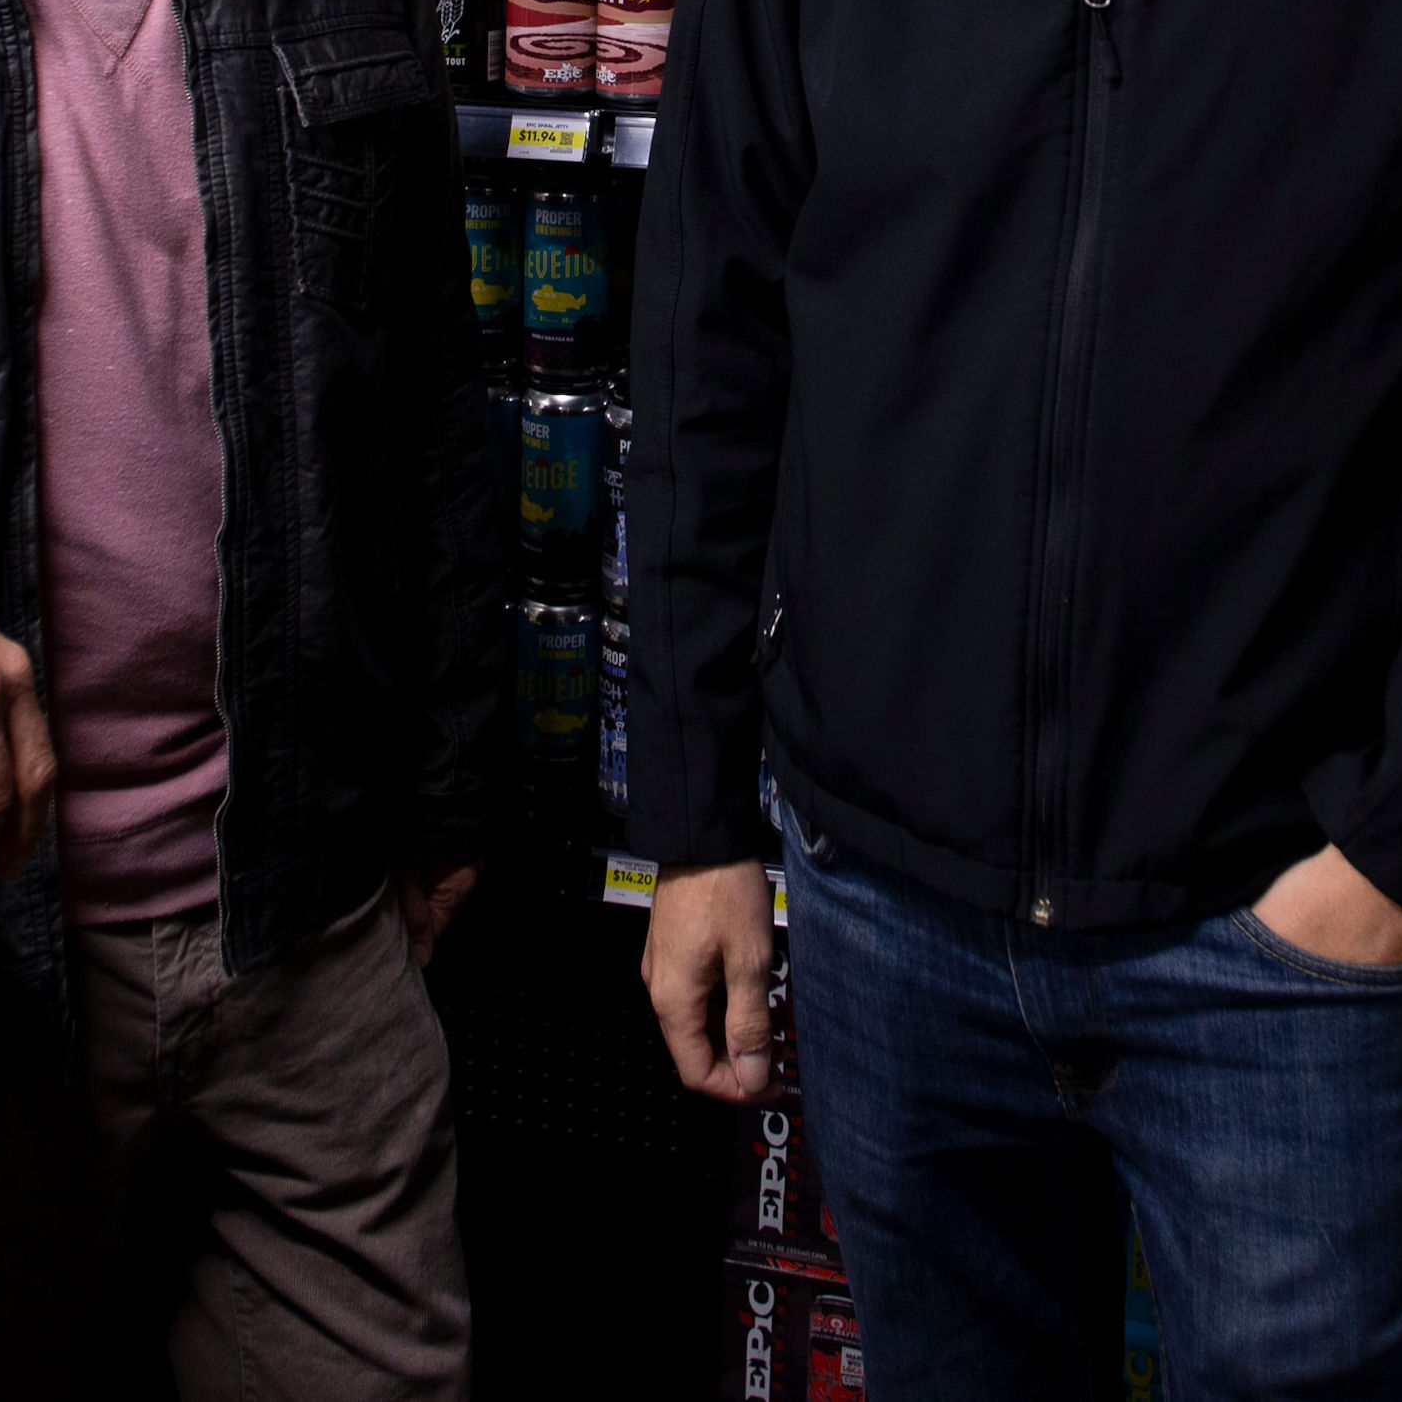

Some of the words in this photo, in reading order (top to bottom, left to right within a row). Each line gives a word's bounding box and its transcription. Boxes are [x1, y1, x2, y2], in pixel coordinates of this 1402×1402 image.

[518, 129, 556, 143] $11.94
[536, 209, 582, 226] PROPER
[539, 633, 586, 649] PROPER
[613, 870, 653, 886] $14.20
